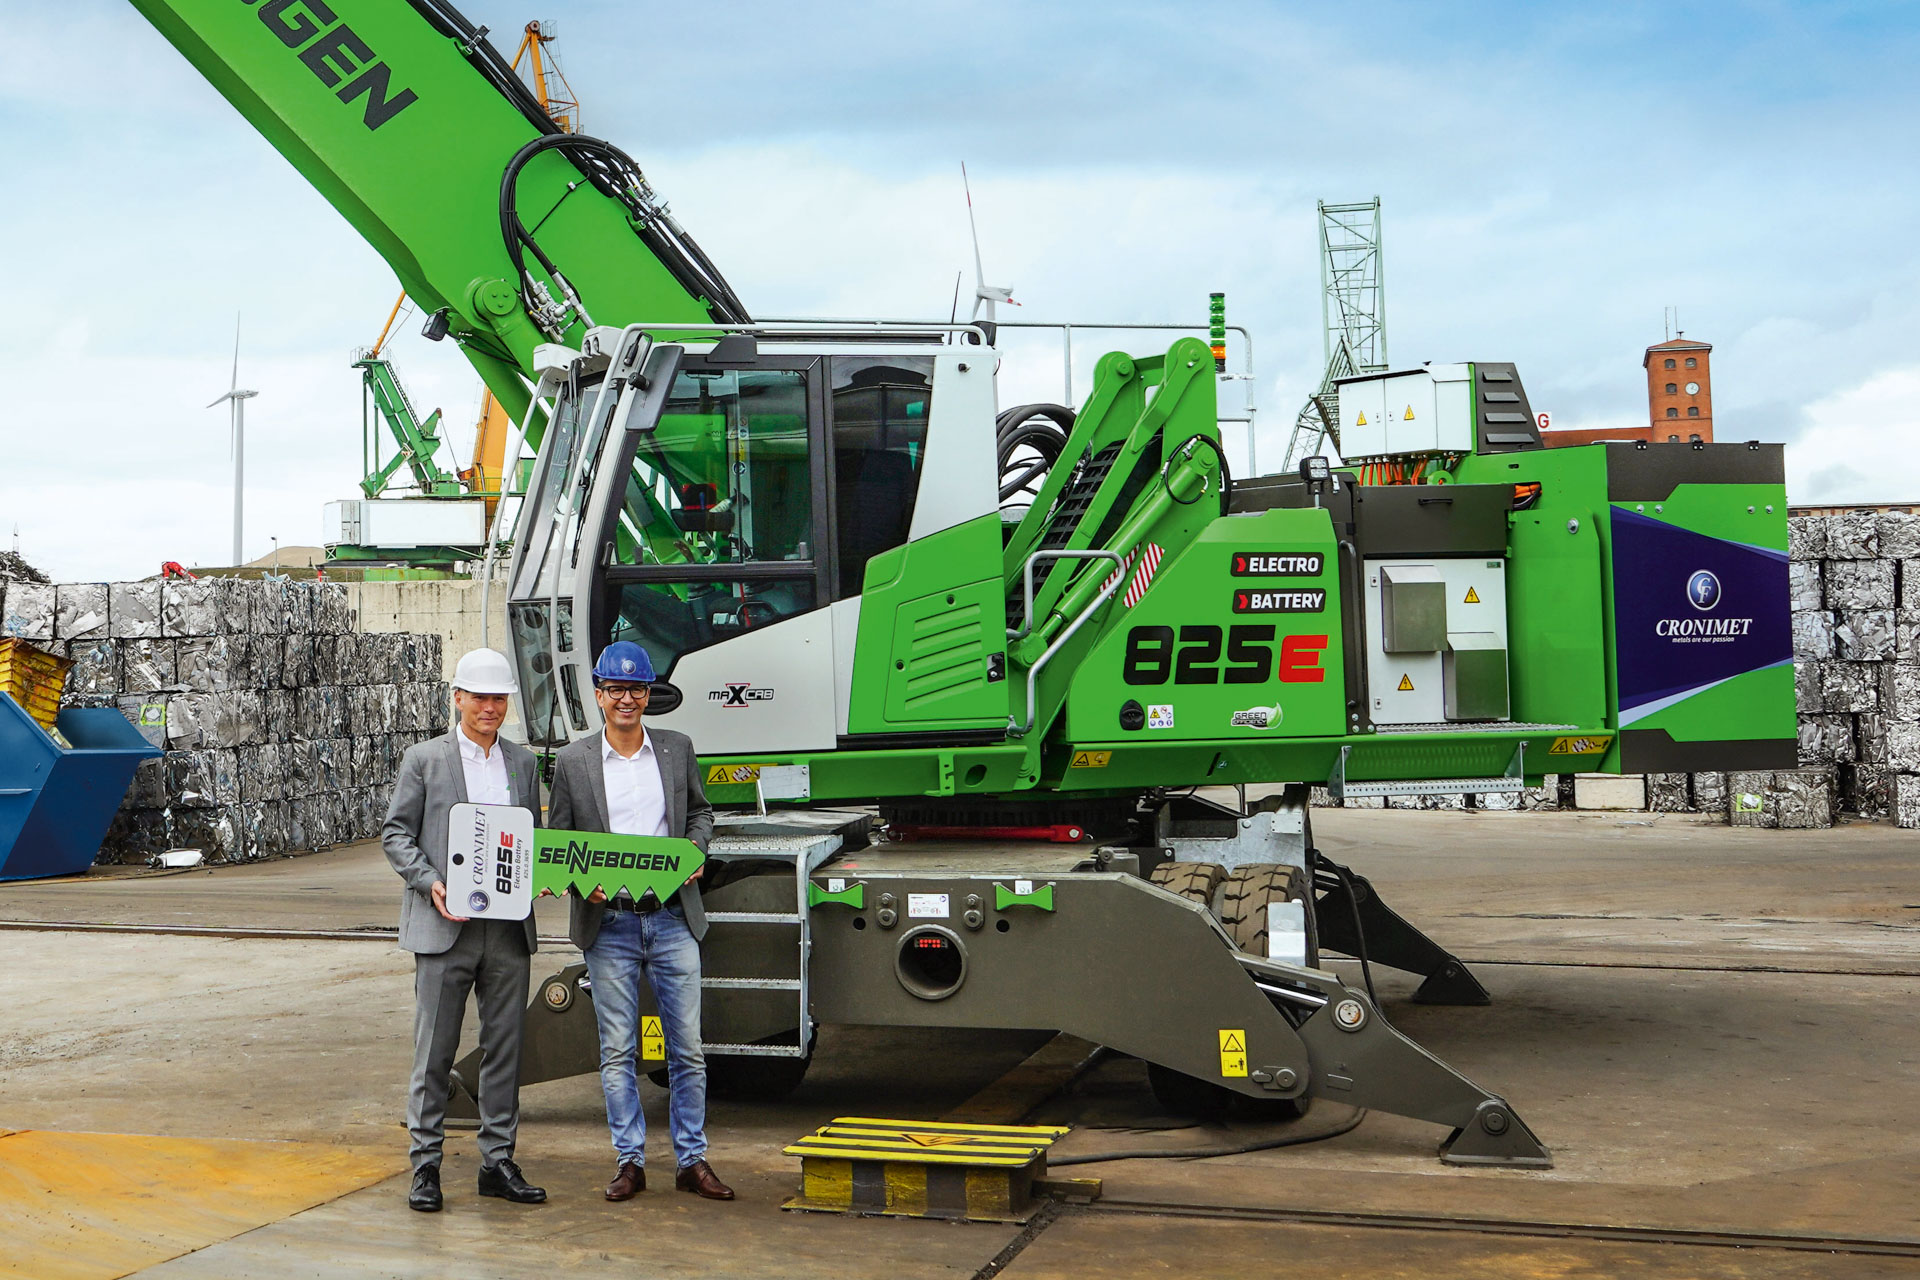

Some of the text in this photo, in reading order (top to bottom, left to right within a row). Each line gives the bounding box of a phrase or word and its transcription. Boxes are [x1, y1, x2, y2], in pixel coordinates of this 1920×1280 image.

[241, 0, 419, 131] GEN
[1537, 413, 1549, 429] G
[1249, 557, 1319, 573] ELECTRO
[1251, 593, 1324, 609] BATTERY
[1655, 618, 1753, 636] CRONIMET
[1712, 635, 1735, 644] passion
[1123, 624, 1329, 685] 825E
[472, 808, 486, 885] CRONIMET
[496, 831, 513, 895] 825E
[513, 838, 524, 889] Electro Battery
[538, 840, 681, 874] SENNEBOGEN
